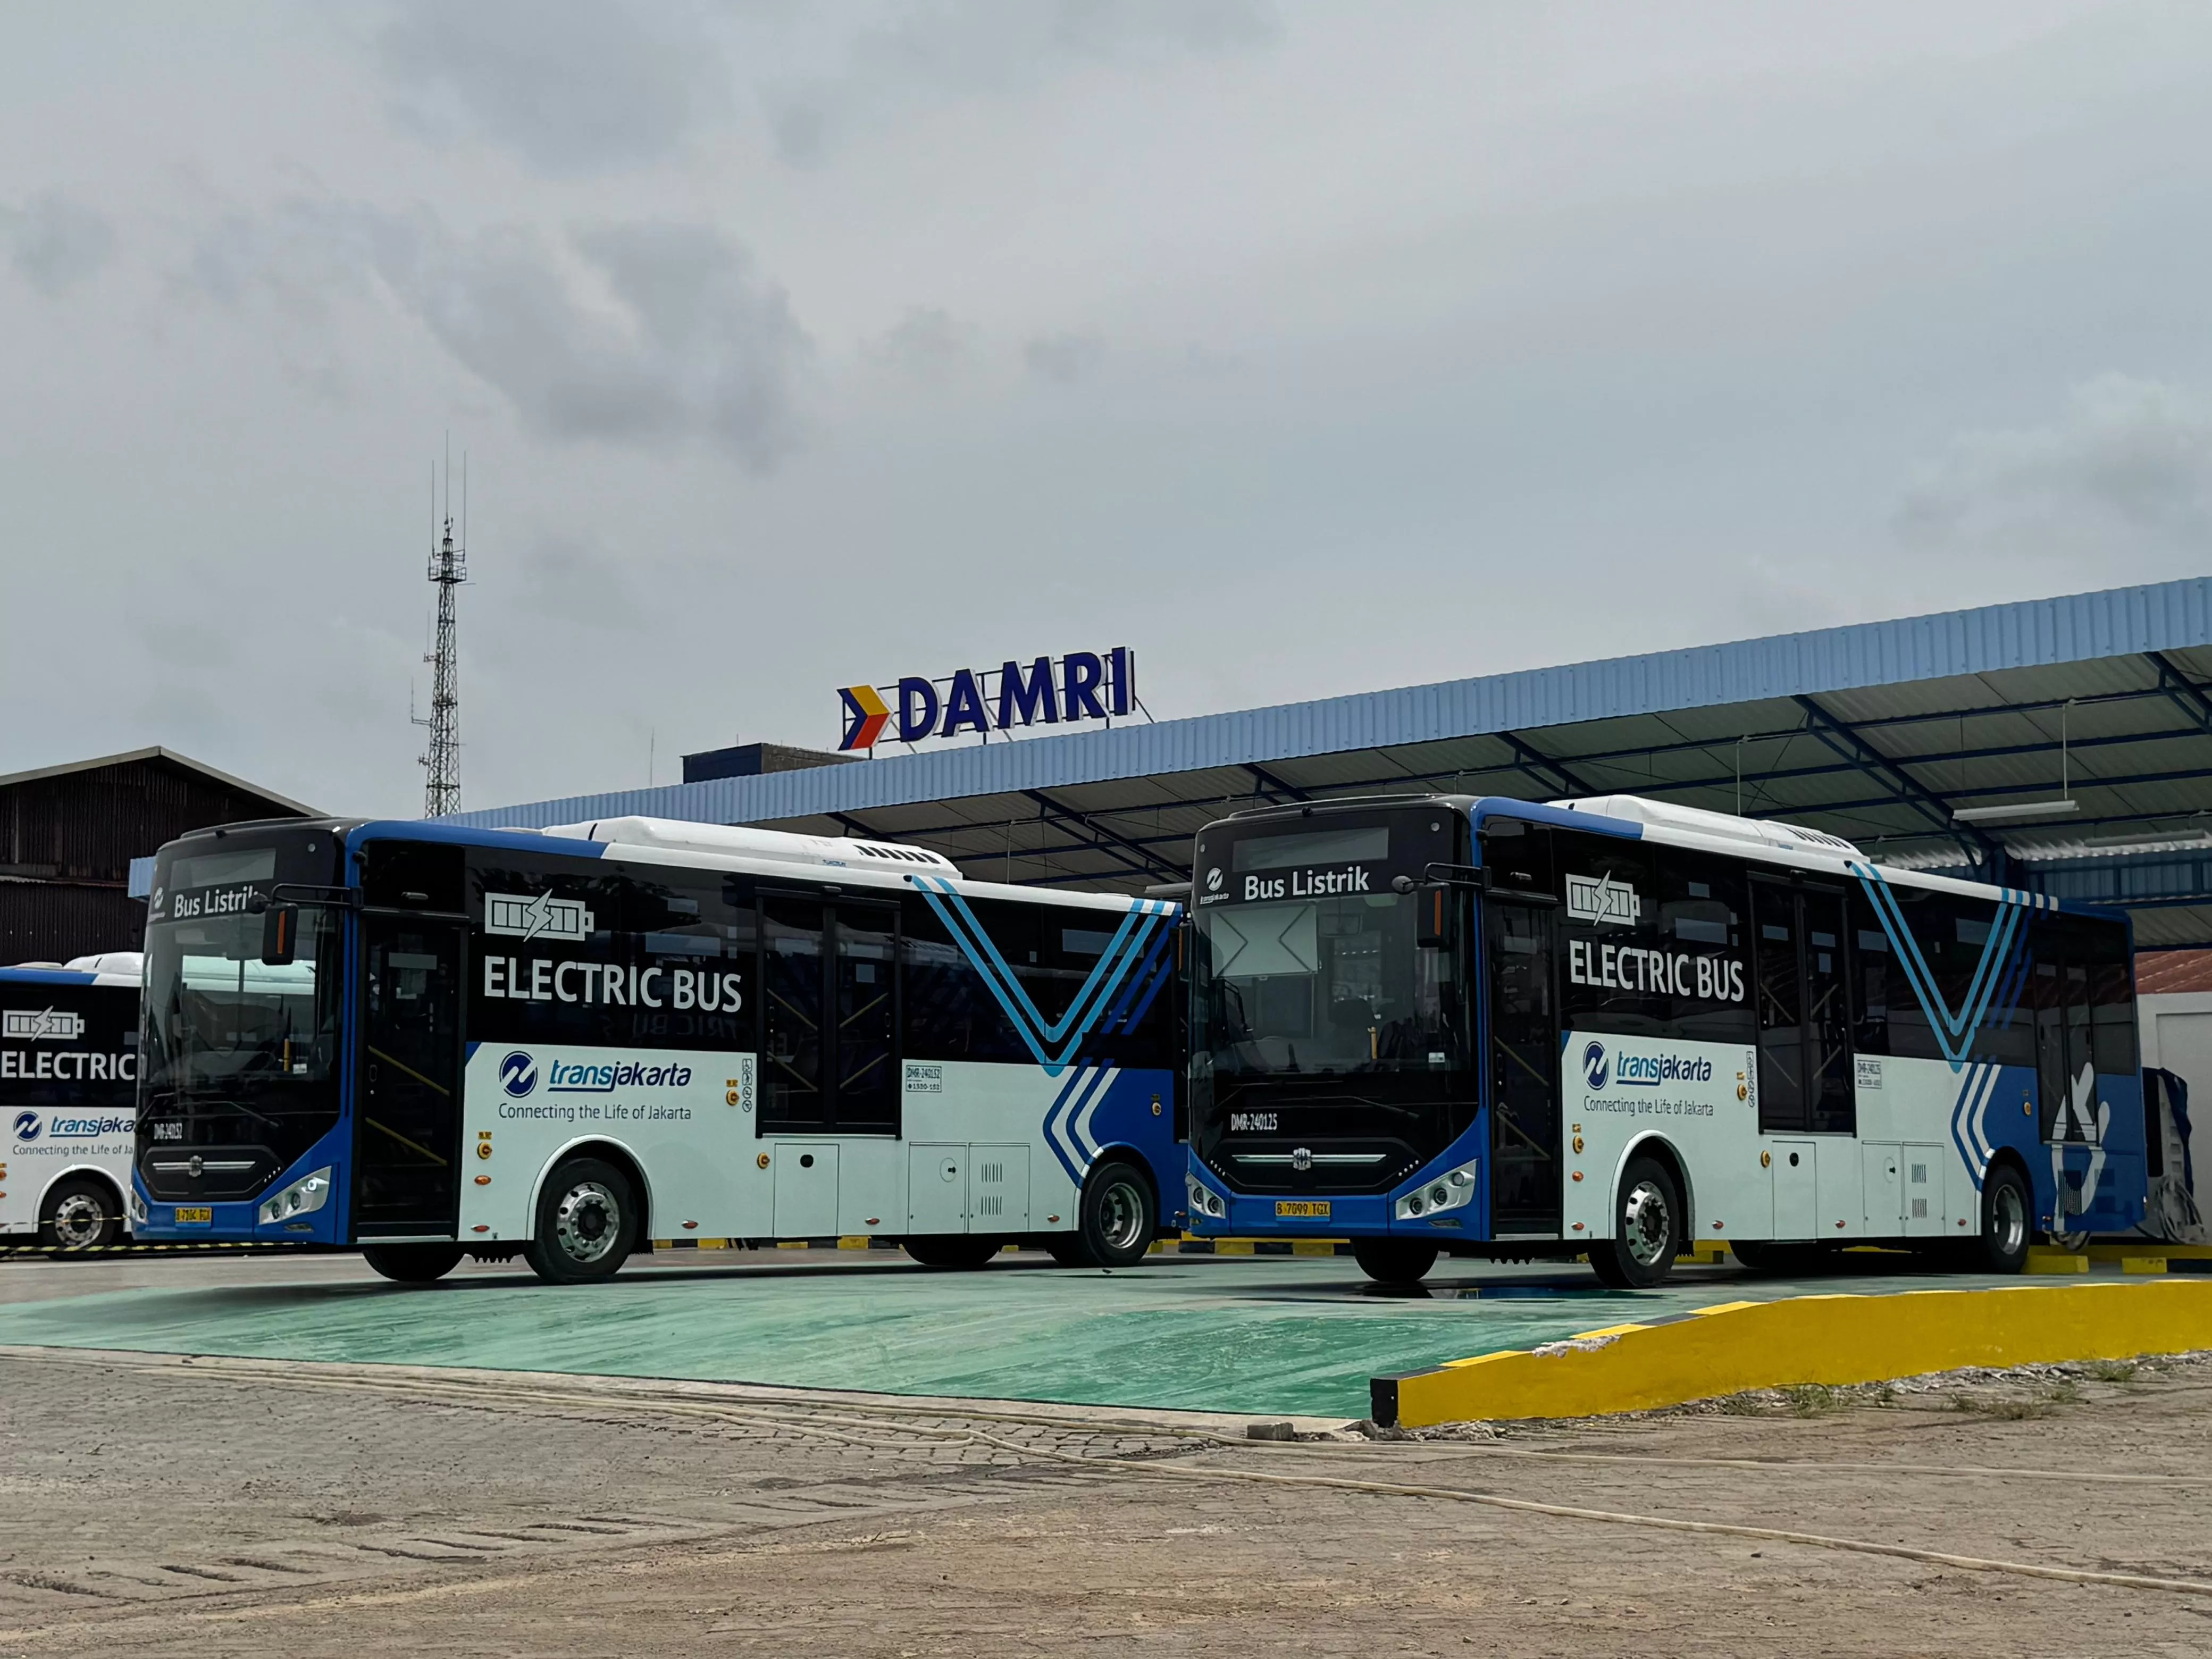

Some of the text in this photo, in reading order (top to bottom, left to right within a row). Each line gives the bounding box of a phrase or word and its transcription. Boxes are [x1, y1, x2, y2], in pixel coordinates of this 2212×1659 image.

[899, 647, 1132, 743] DAMRI
[1245, 866, 1370, 900] Bus Listrik
[174, 894, 200, 918] Bus
[484, 955, 742, 1012] ELECTRIC BUS
[1570, 940, 1744, 1002] ELECTRIC BUS
[1, 1051, 136, 1080] ELECTRIC
[548, 1059, 692, 1092] transjakarta
[1616, 1050, 1712, 1086] transjakarta
[499, 1103, 691, 1122] Connecting the Life of Jakarta
[1583, 1095, 1713, 1117] Connecting the Life of Jakarta
[13, 1144, 69, 1157] Connecting
[72, 1145, 88, 1154] the
[91, 1144, 110, 1154] Life
[112, 1145, 122, 1154] of
[1277, 1203, 1282, 1214] B
